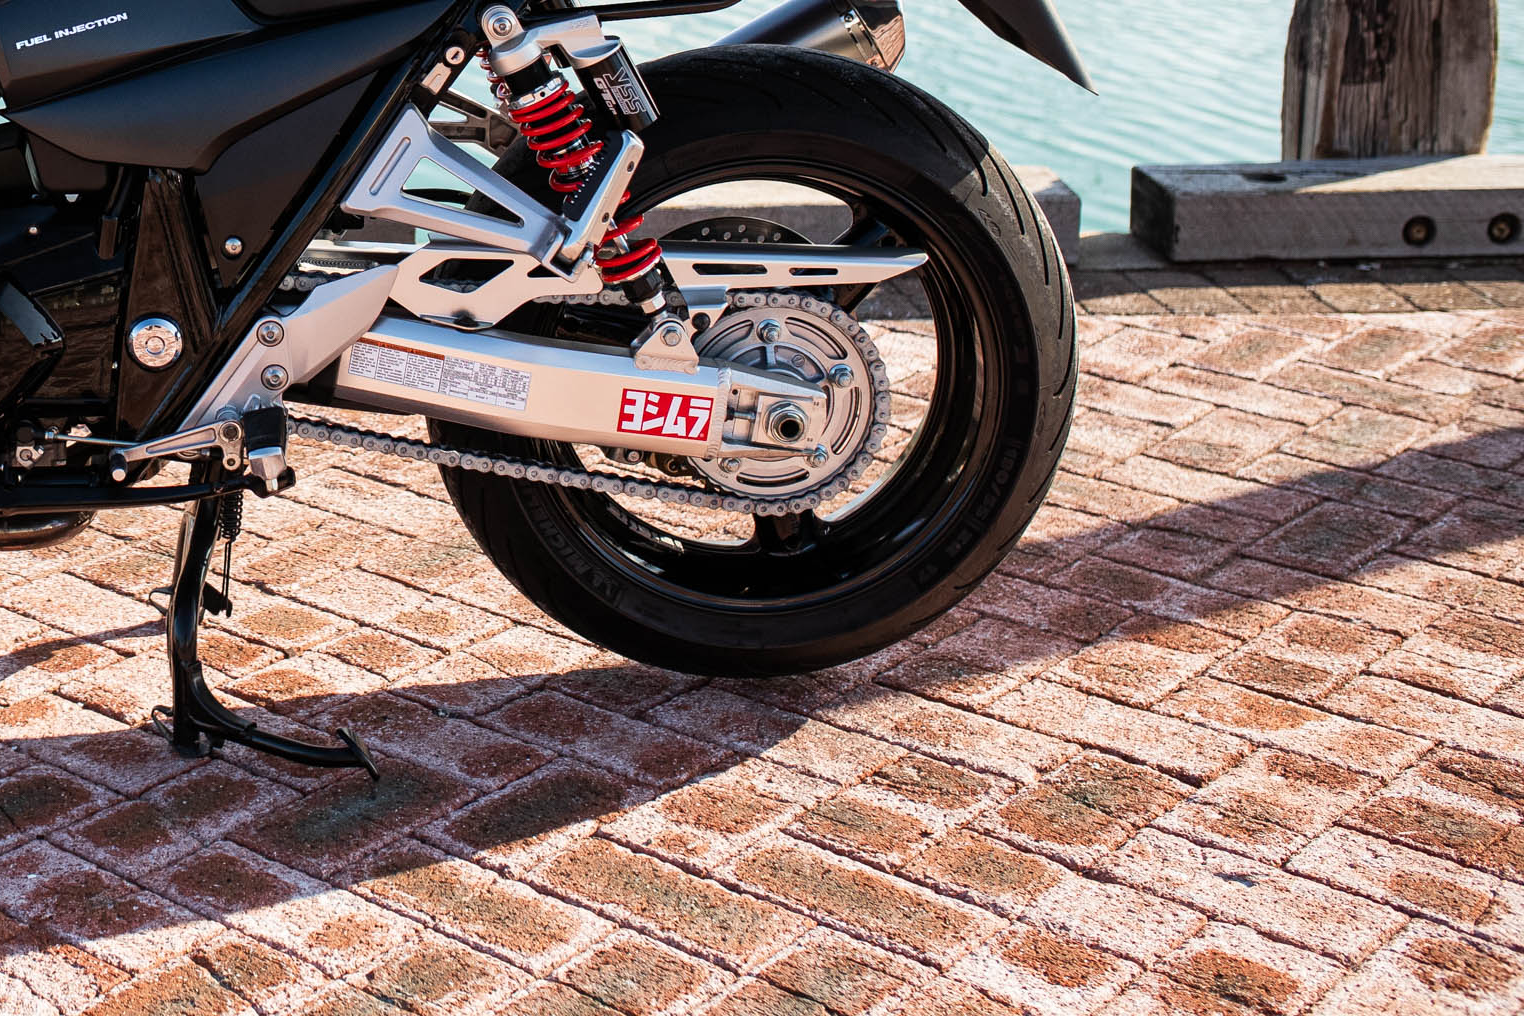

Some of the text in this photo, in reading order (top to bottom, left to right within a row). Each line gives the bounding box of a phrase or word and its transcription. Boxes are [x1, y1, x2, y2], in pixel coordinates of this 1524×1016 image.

[15, 12, 129, 50] FUEL INJECTION
[603, 67, 646, 115] YSS
[621, 390, 712, 438] ヨシムラ
